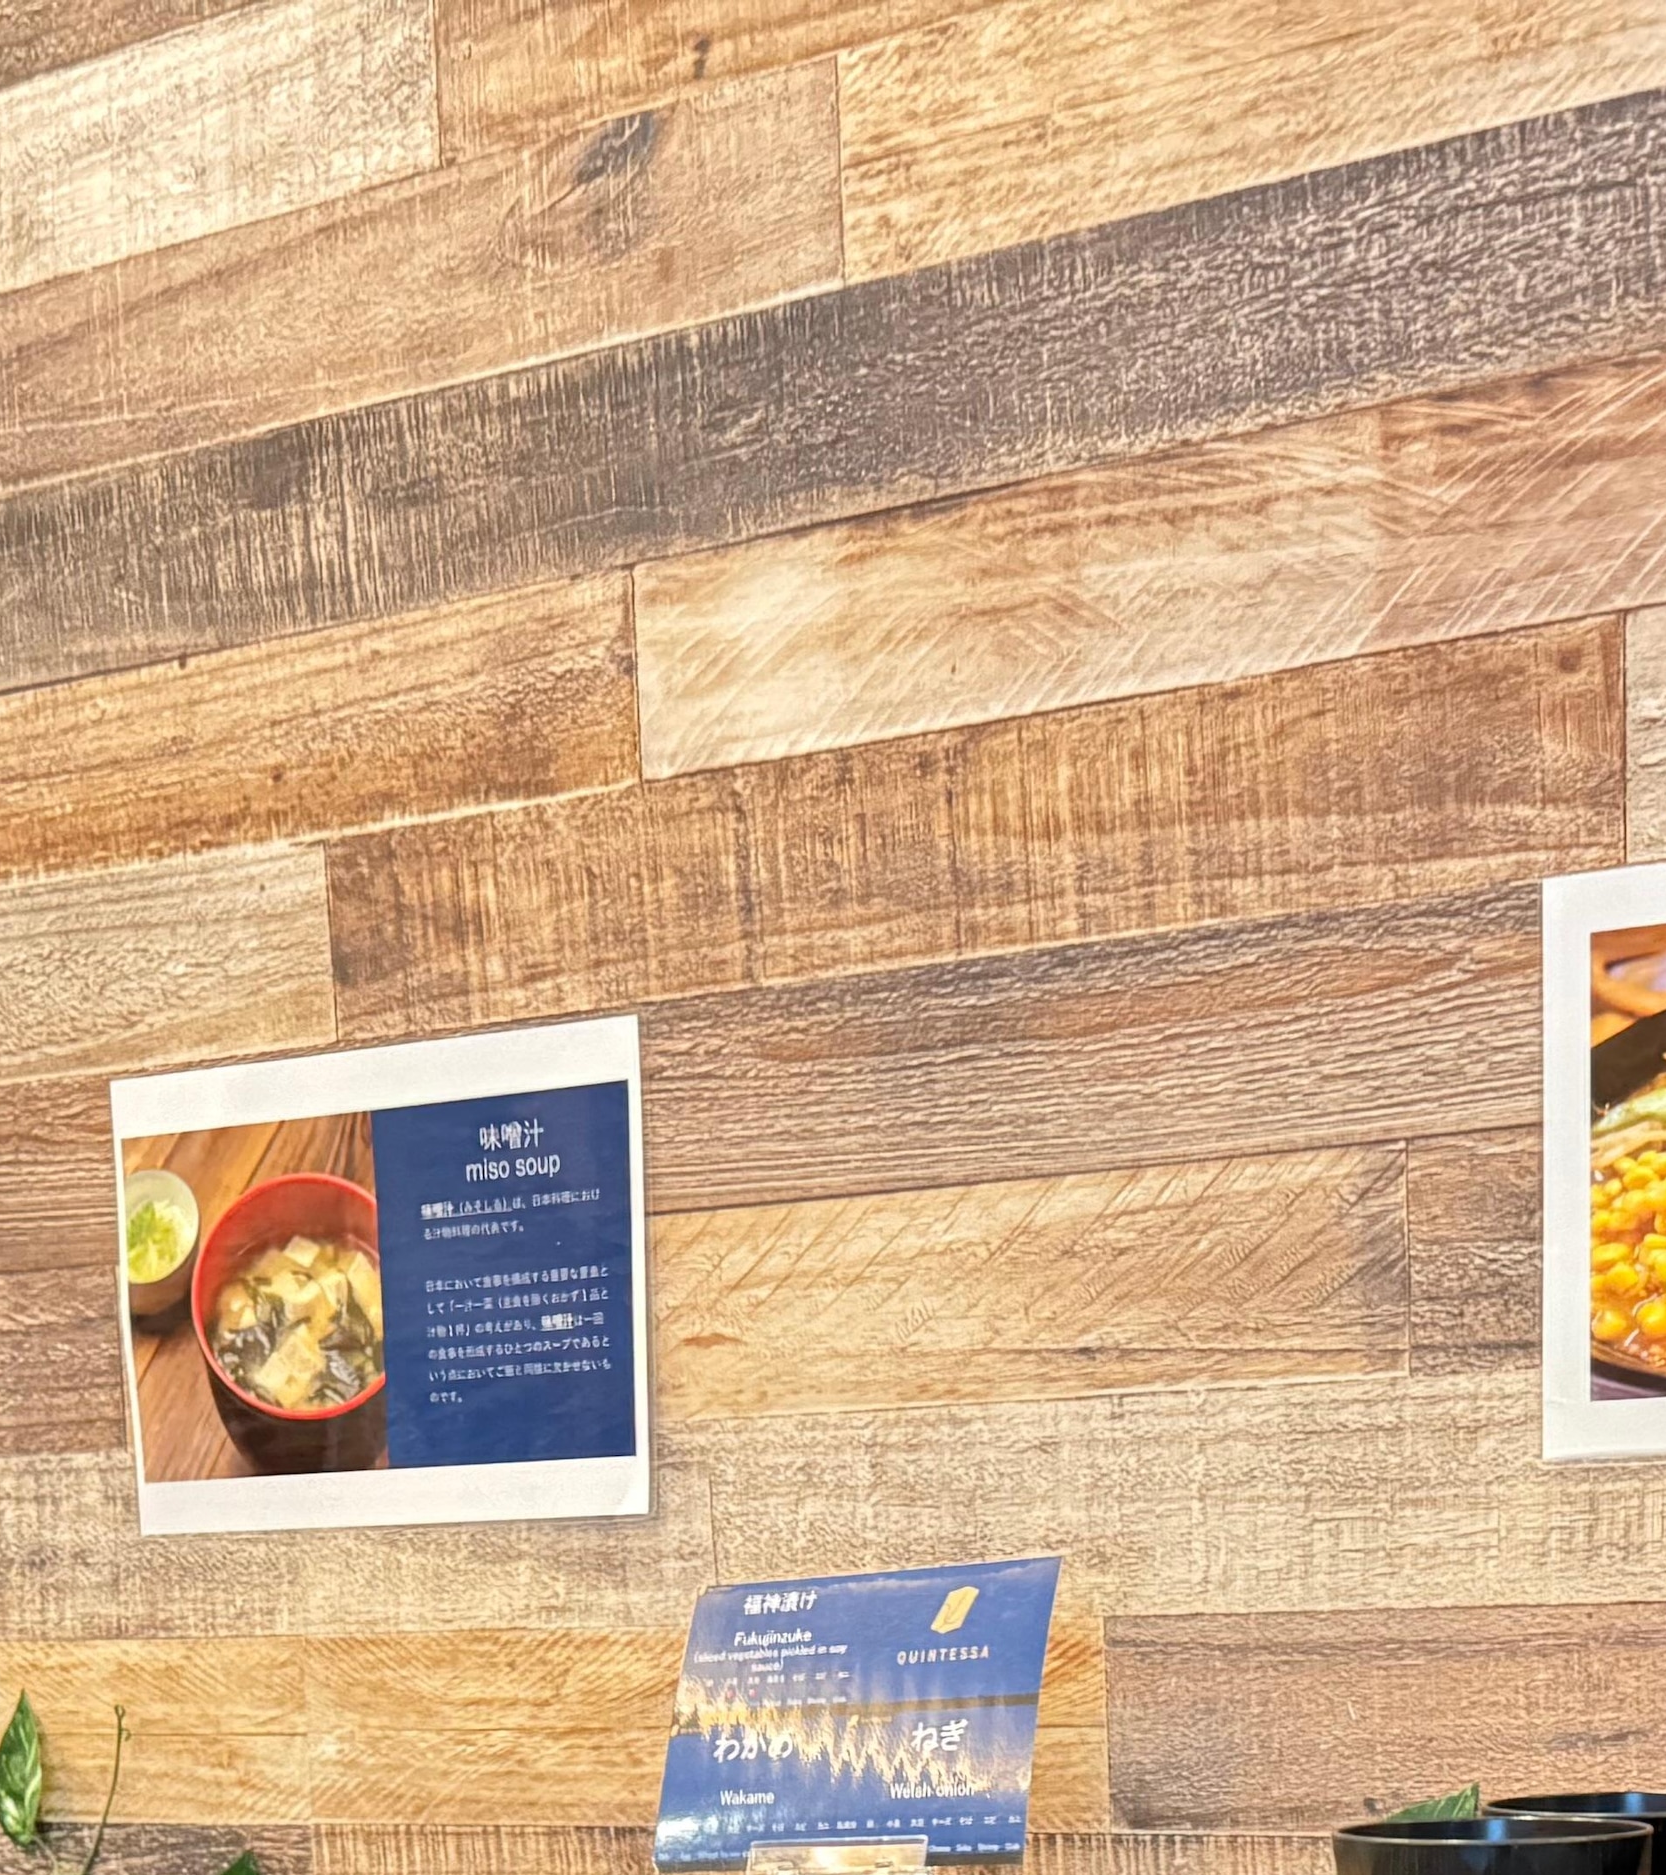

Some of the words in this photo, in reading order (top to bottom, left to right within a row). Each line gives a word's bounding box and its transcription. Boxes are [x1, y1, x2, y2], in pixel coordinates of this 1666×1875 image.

[478, 1118, 545, 1151] 味噌汁
[465, 1156, 510, 1183] miso
[514, 1153, 561, 1181] soup
[897, 1645, 990, 1666] QUINTESSA
[713, 1735, 793, 1764] わかめ
[910, 1717, 969, 1753] ねぎ
[720, 1789, 775, 1806] Wakame
